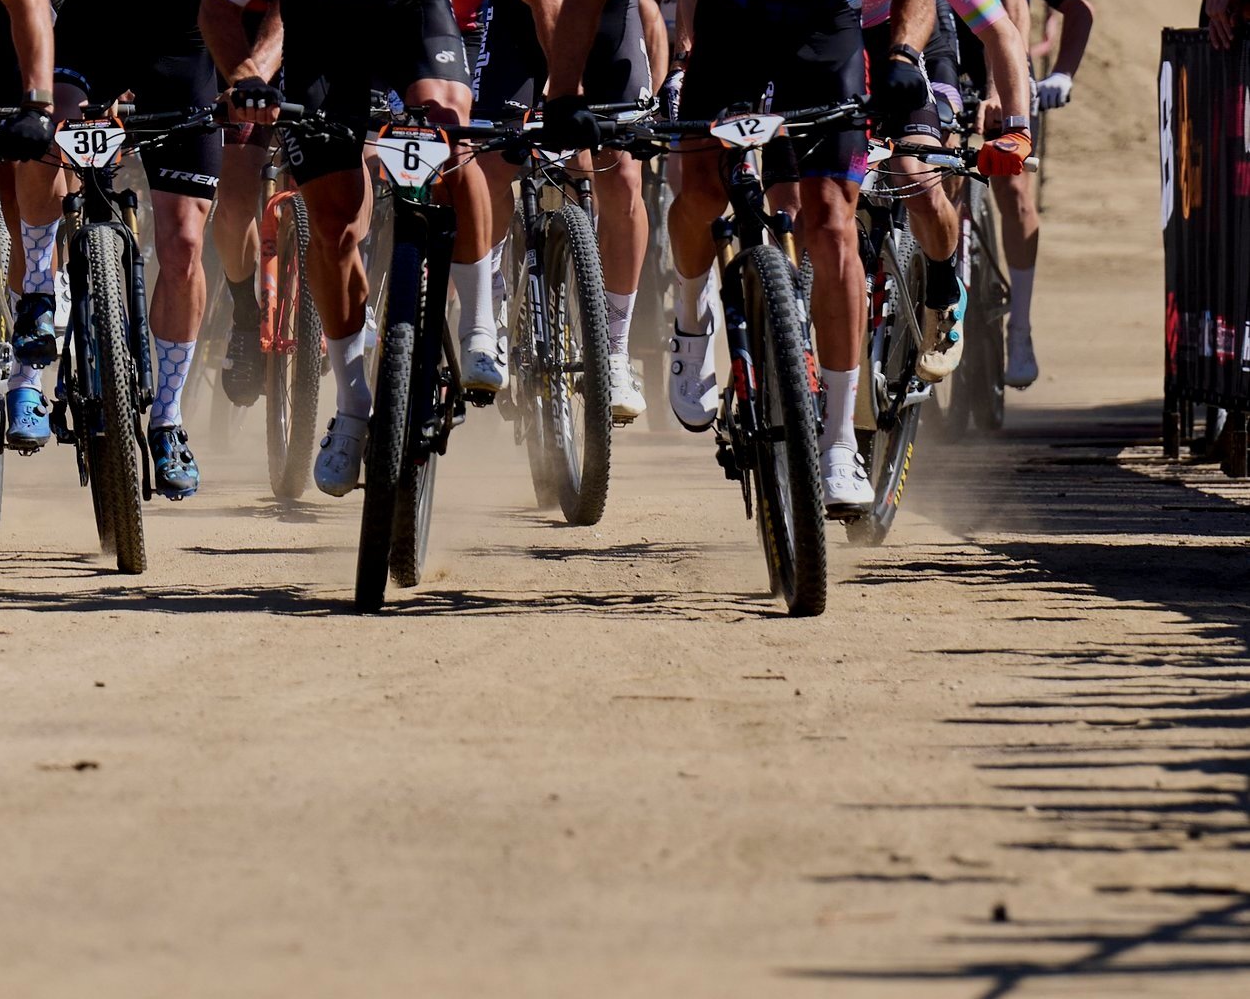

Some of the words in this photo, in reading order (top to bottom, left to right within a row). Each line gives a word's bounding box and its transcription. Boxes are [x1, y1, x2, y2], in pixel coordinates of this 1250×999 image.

[732, 118, 766, 137] 12
[73, 130, 108, 155] 30
[404, 141, 420, 171] 6
[158, 167, 221, 188] TREK
